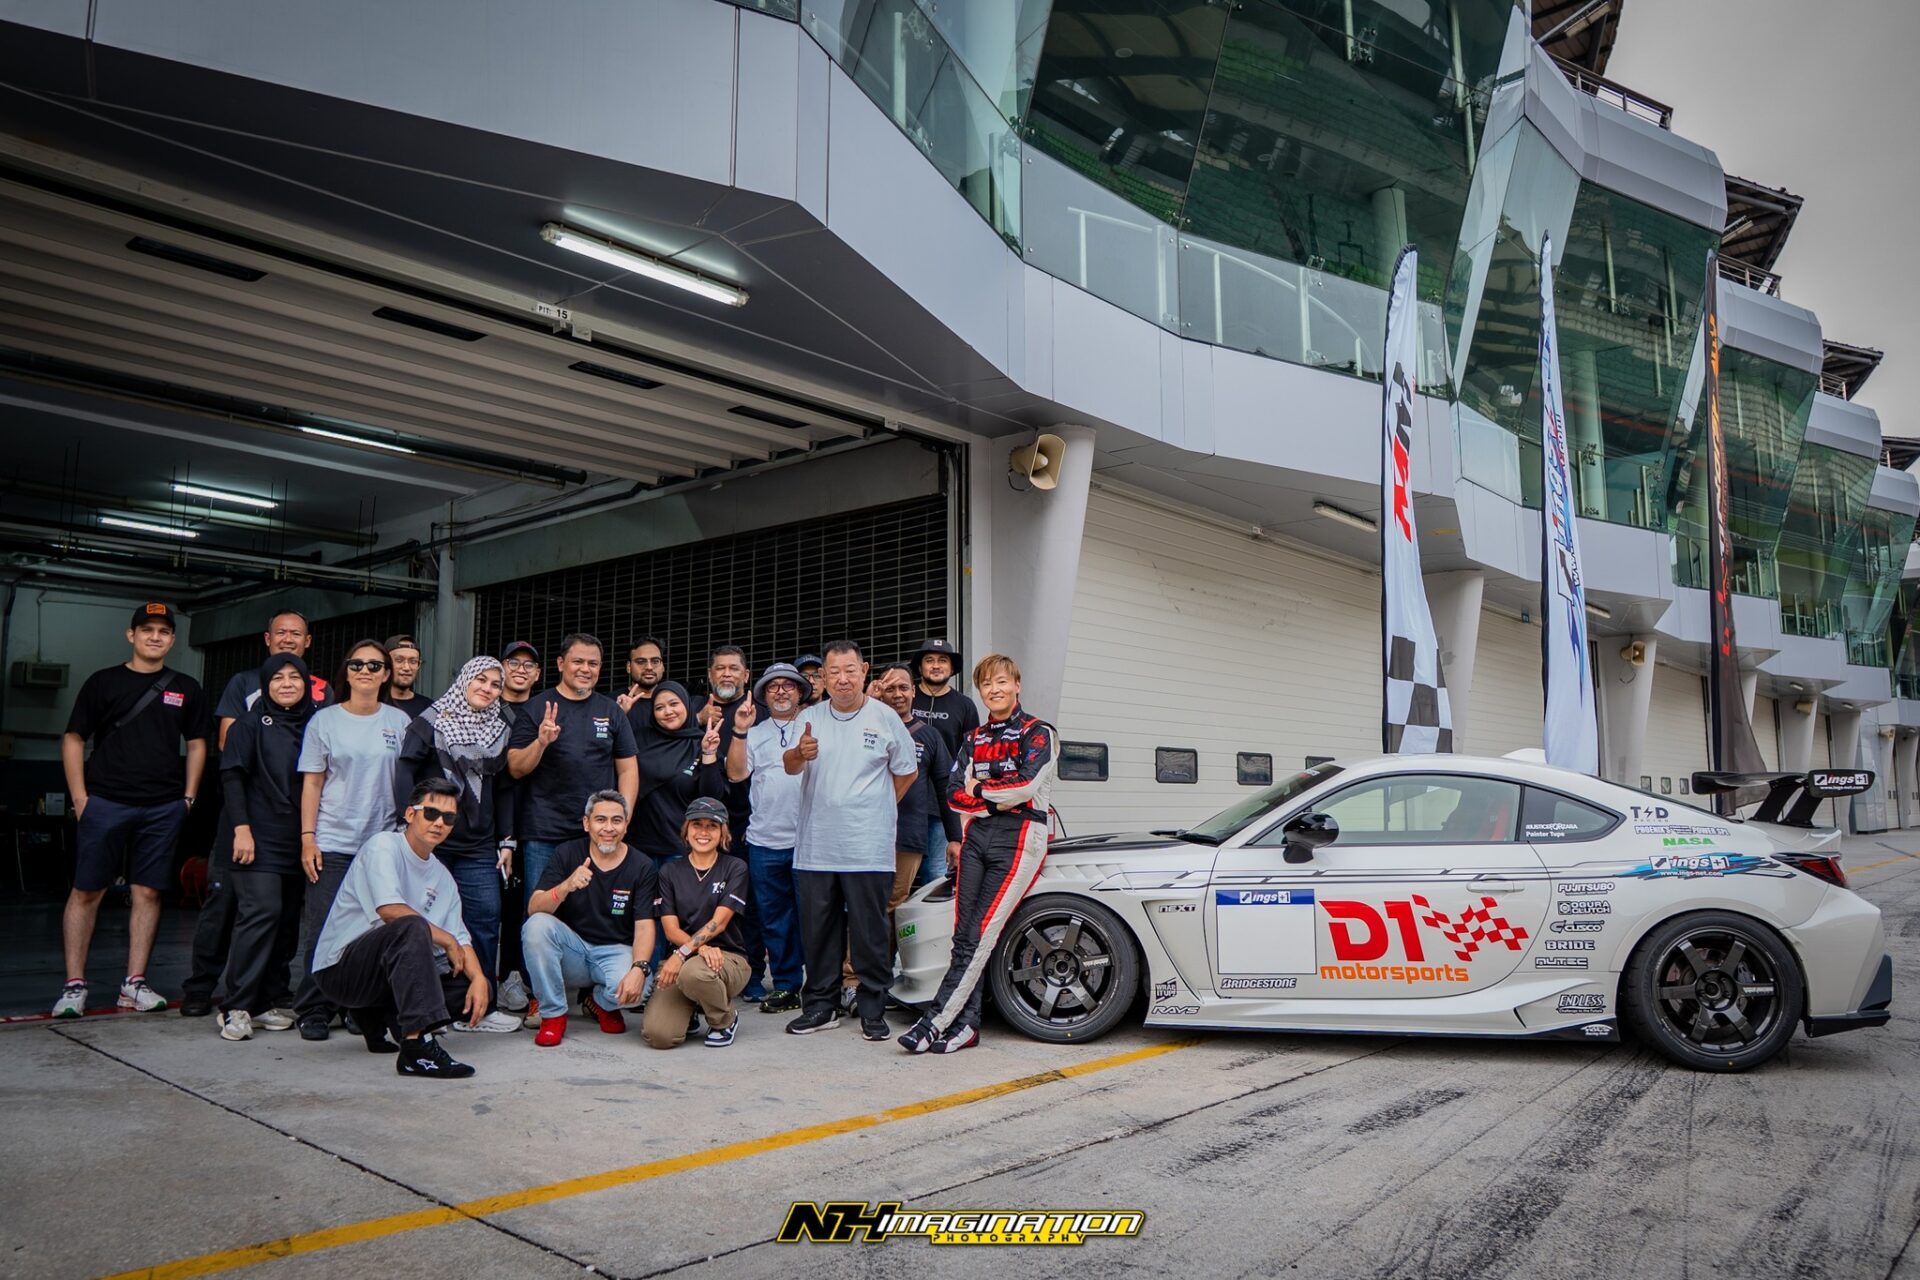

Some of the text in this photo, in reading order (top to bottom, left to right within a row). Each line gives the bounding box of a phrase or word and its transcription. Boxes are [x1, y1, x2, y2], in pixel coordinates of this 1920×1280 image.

[556, 309, 568, 319] 15
[911, 708, 949, 720] RECARO
[1663, 837, 1715, 847] NASA
[1558, 882, 1616, 893] FUJITSUBO
[1319, 900, 1425, 962] D1
[1545, 940, 1595, 950] BRIDE
[1320, 963, 1469, 984] motorsports
[1221, 978, 1297, 989] BRIDGESTONE
[1559, 995, 1604, 1006] ENDLESS
[1152, 1006, 1200, 1015] RAYS
